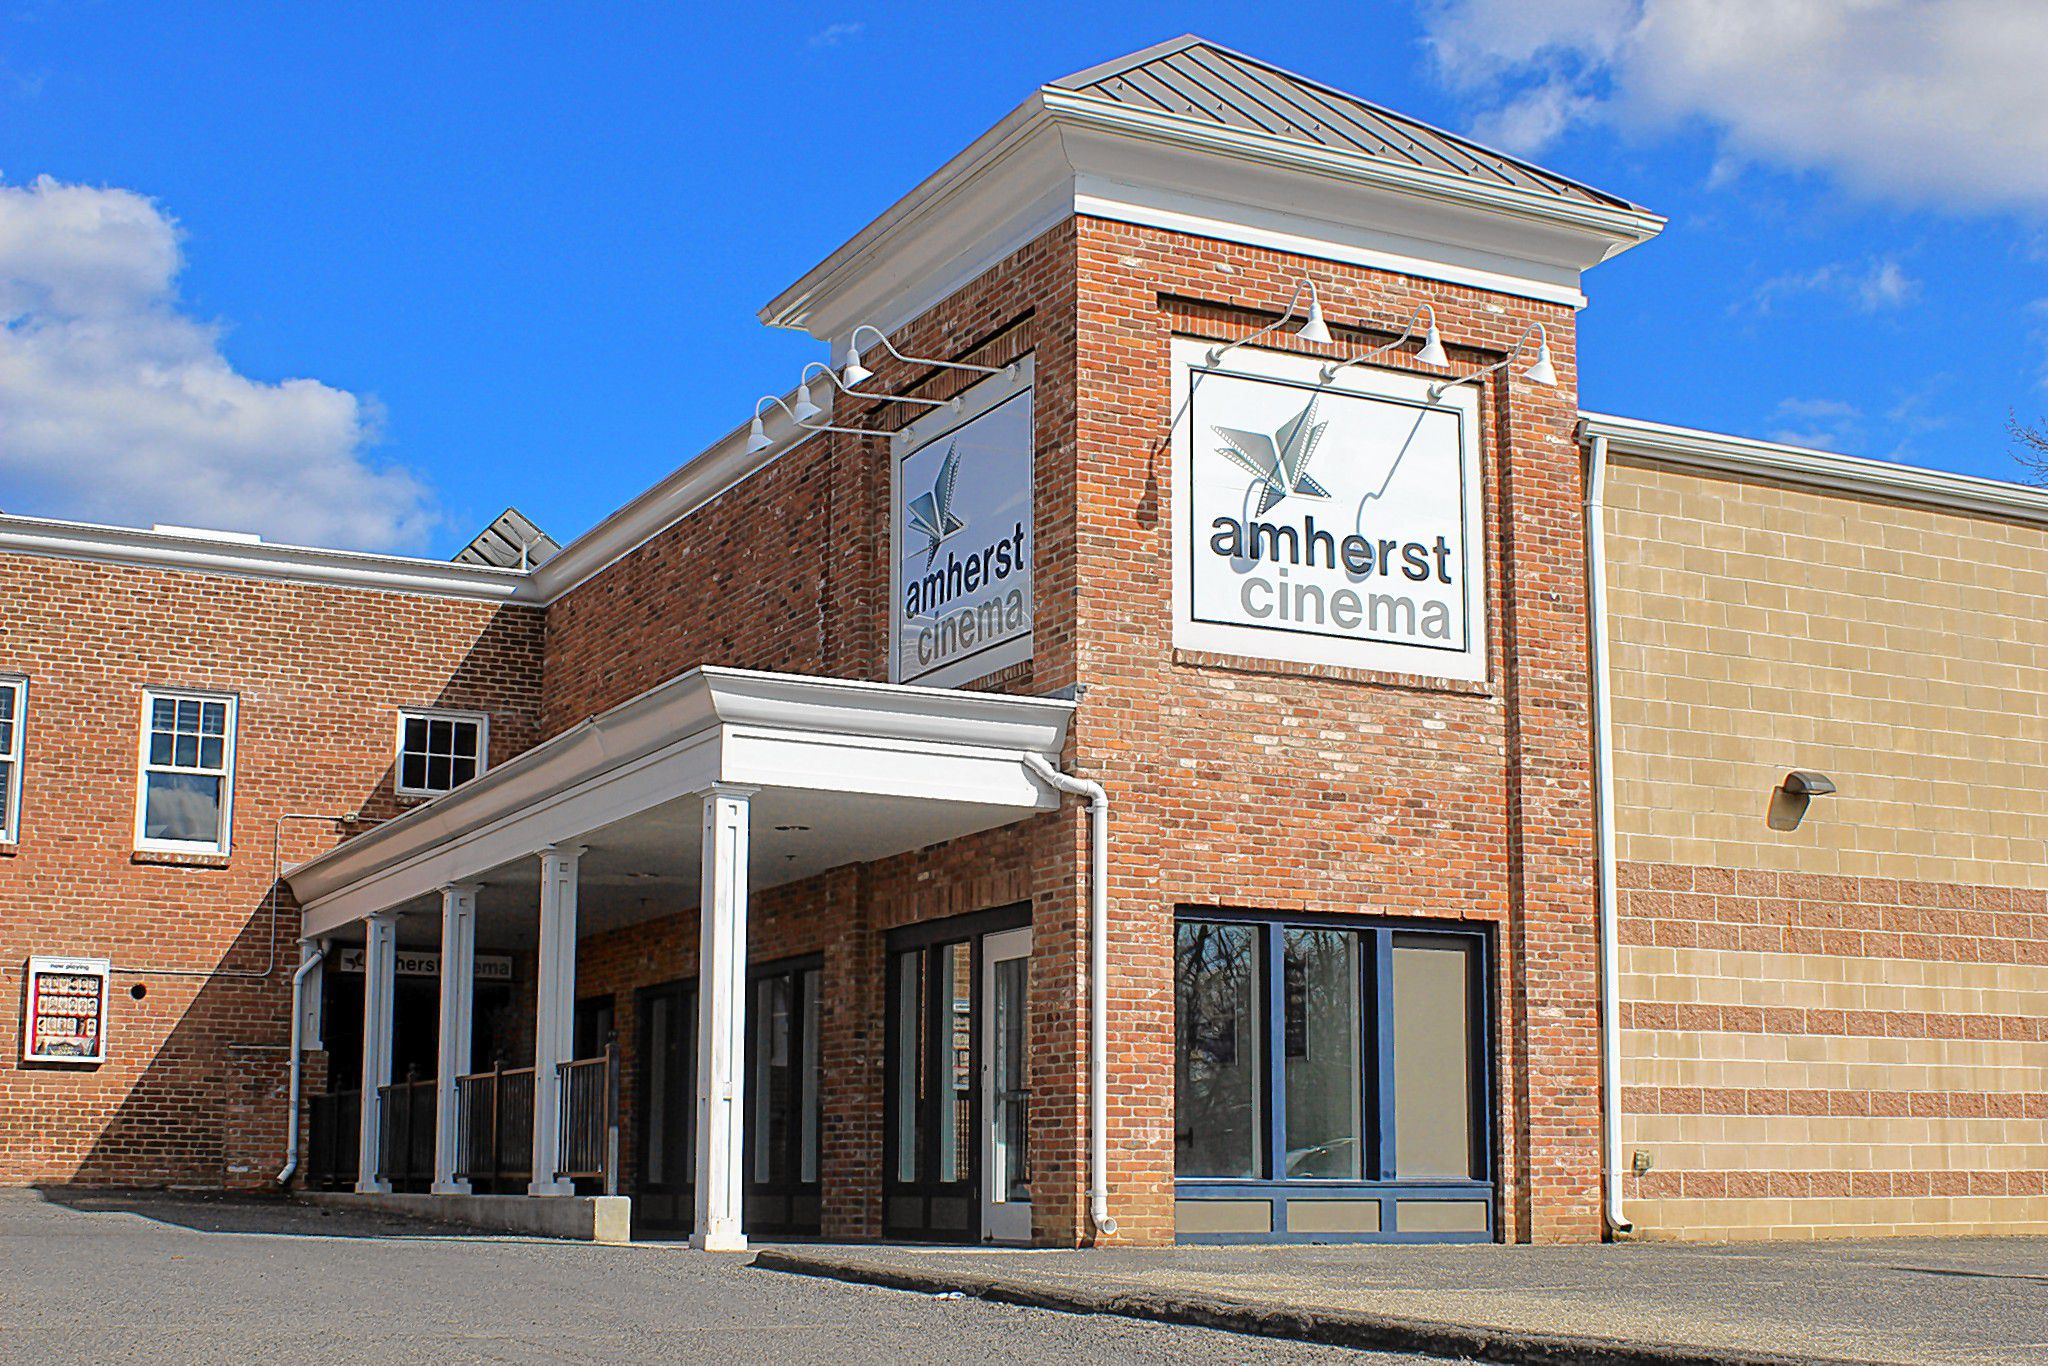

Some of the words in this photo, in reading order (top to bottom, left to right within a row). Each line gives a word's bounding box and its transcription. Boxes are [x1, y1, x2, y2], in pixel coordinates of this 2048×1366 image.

[906, 521, 1025, 619] amherst
[1209, 515, 1452, 585] amherst
[917, 588, 1023, 666] cinema
[1240, 567, 1451, 640] cinema
[396, 956, 441, 972] hers
